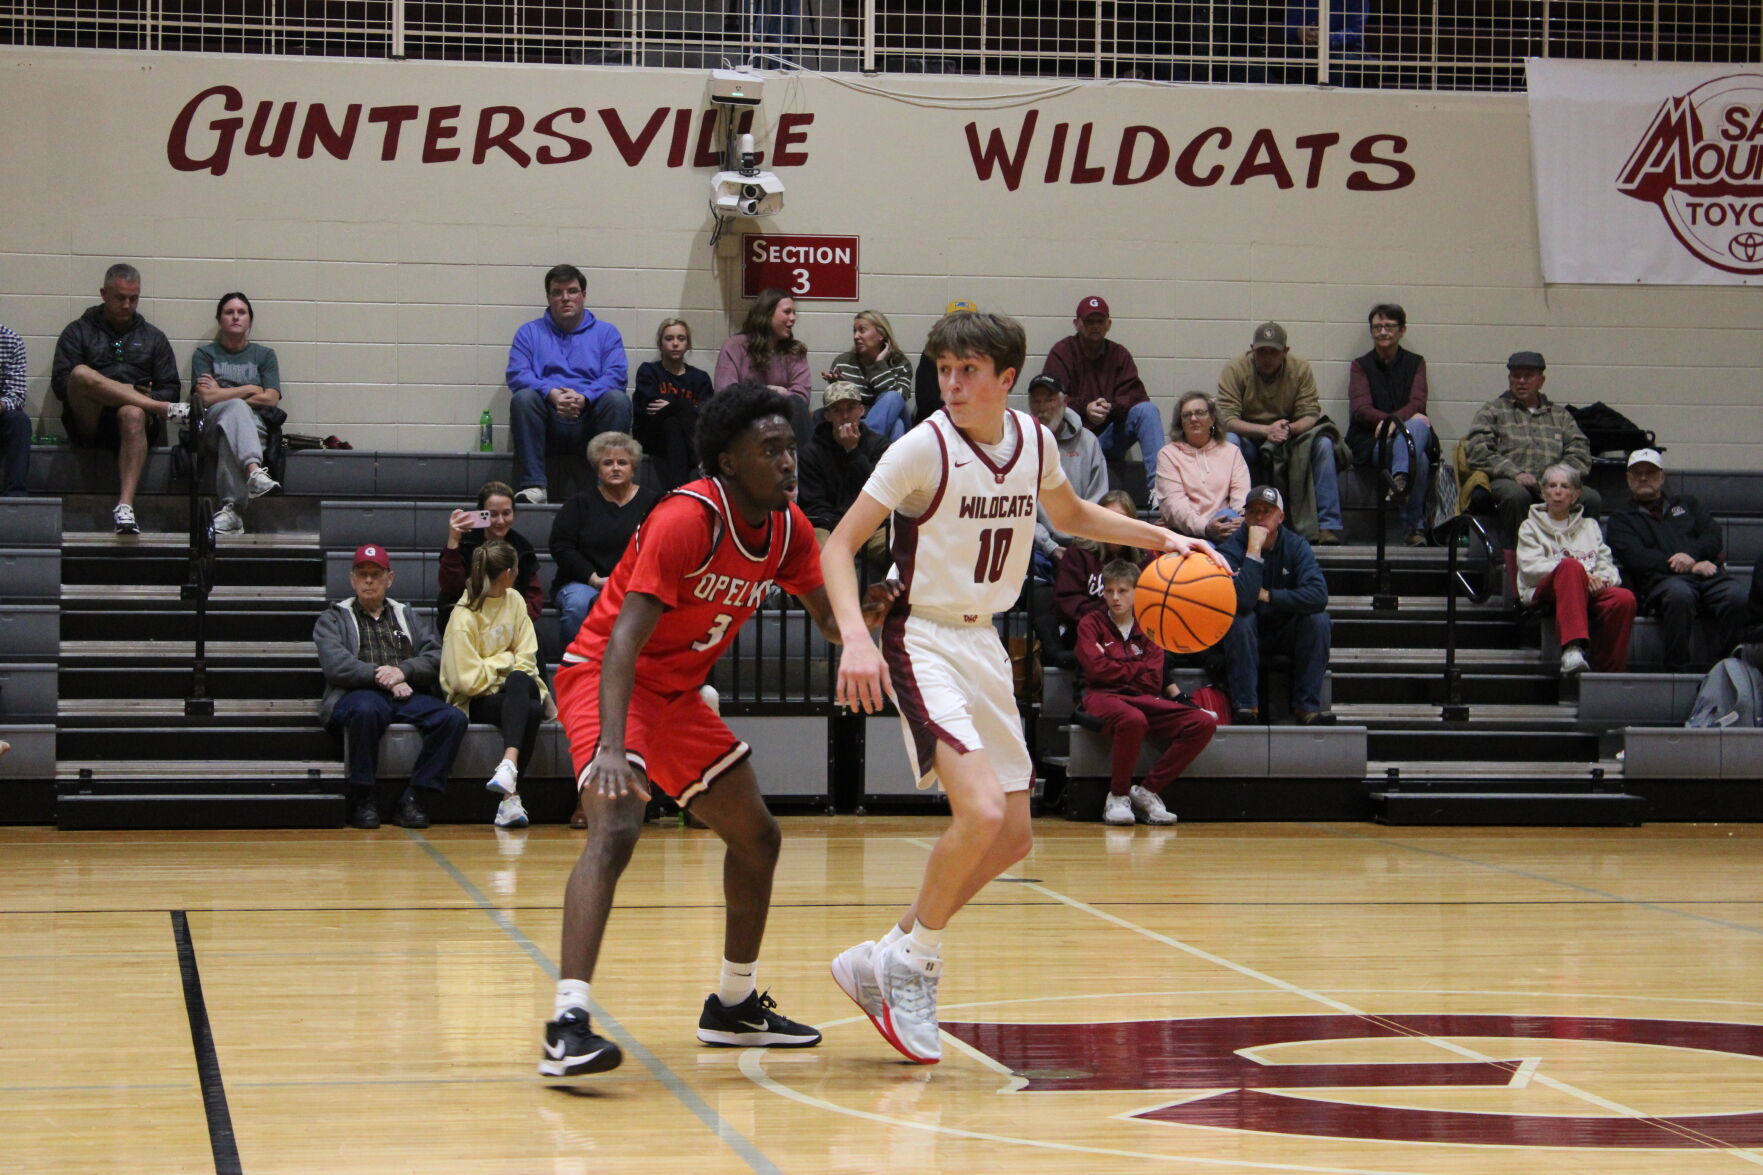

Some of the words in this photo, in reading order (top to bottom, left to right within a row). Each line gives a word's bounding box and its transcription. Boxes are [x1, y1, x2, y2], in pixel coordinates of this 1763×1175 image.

[964, 109, 1416, 192] WILDCATS
[790, 268, 811, 294] 3
[1089, 299, 1099, 307] G
[959, 495, 1034, 519] WILDCATS
[365, 547, 376, 557] G
[974, 528, 1014, 583] 10
[691, 613, 733, 652] 3
